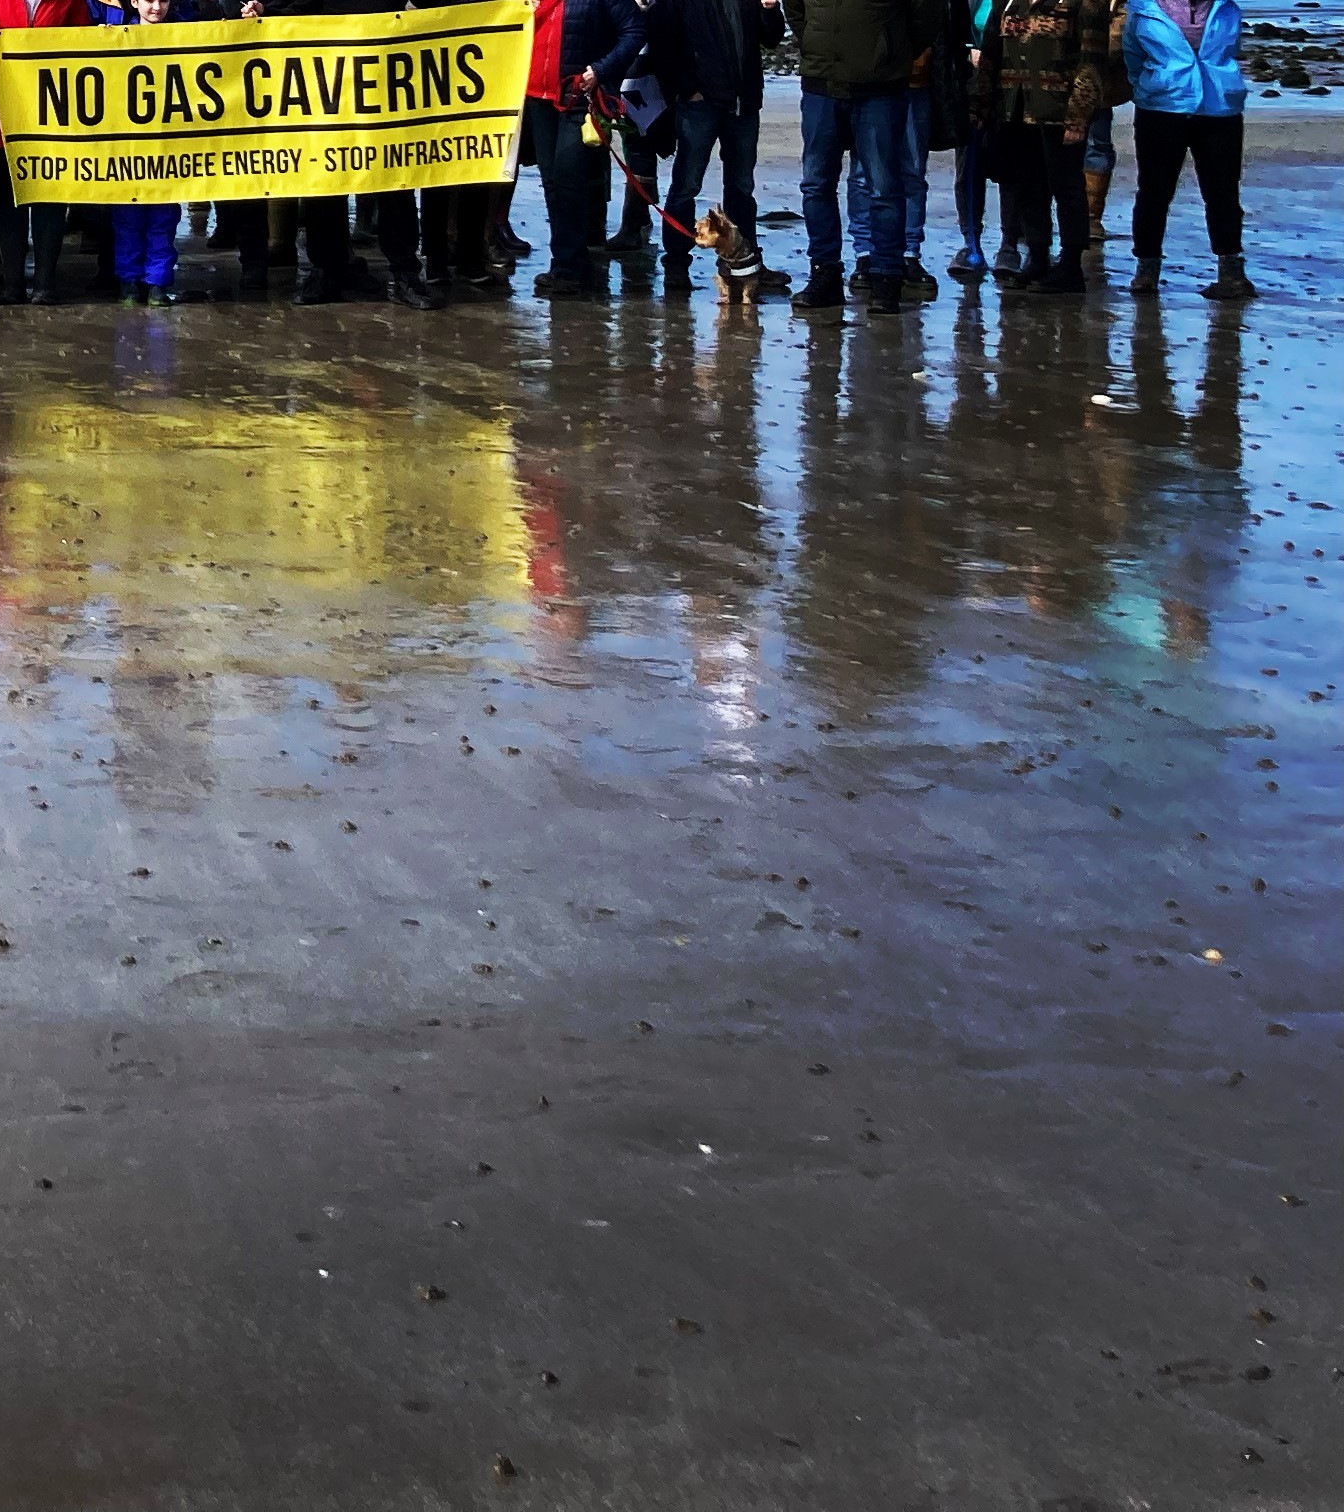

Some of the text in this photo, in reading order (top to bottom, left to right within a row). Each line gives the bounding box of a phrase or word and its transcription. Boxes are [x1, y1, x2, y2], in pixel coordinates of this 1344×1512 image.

[38, 43, 485, 127] NO GAS CAVERNS
[16, 155, 68, 181] STOP
[74, 152, 215, 182] ISLANDMAGEE
[222, 148, 303, 175] ENERGY
[325, 145, 377, 172] STOP
[383, 133, 514, 169] INFRASTRAT
